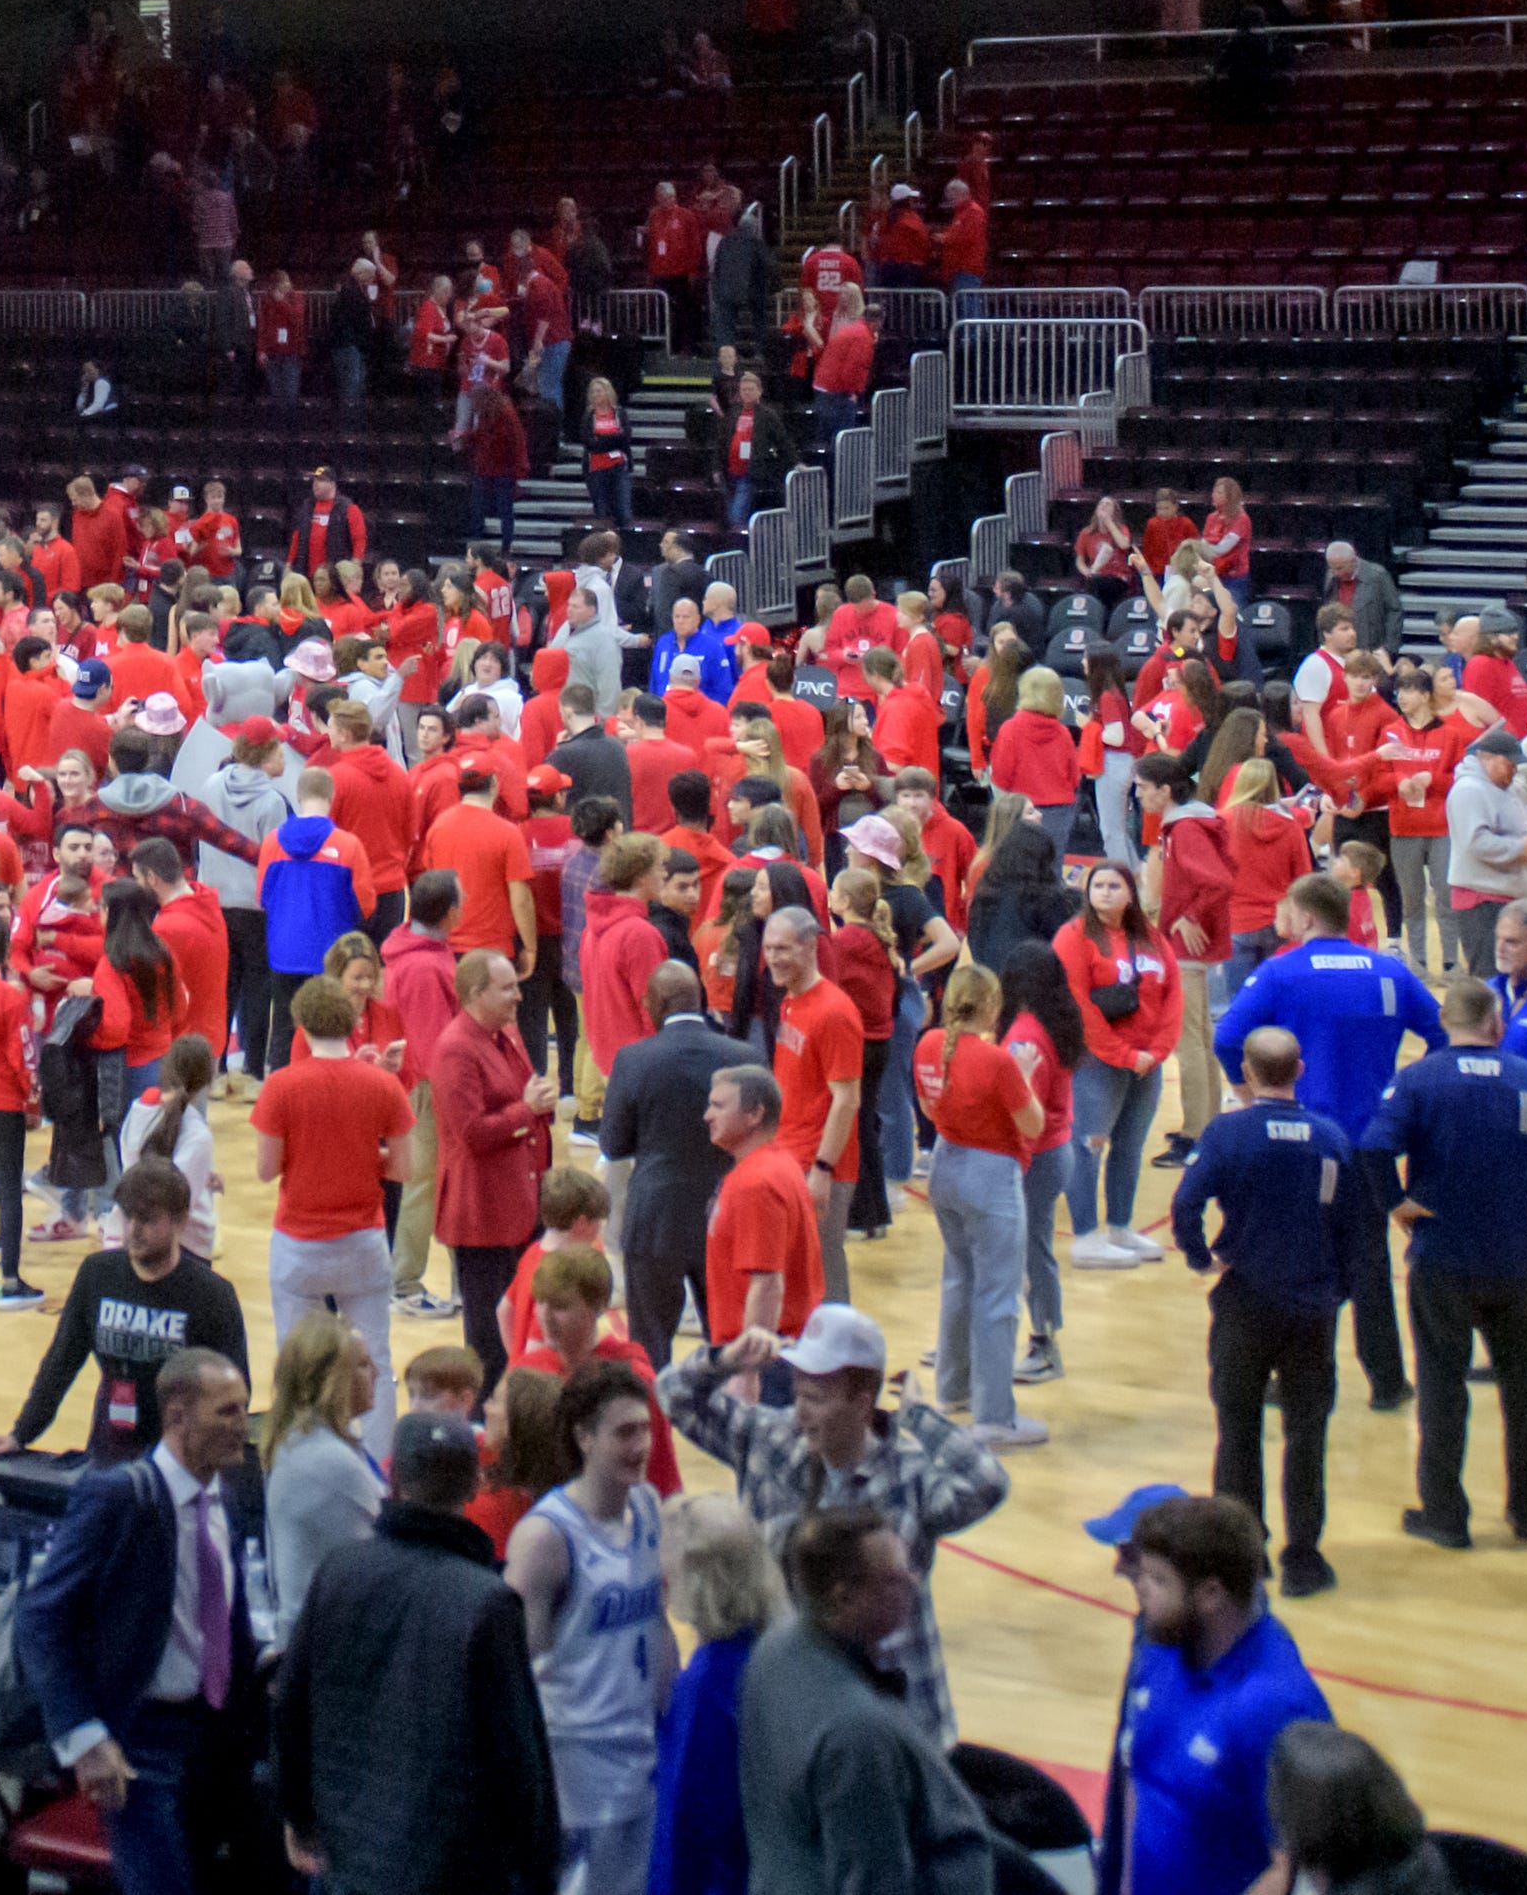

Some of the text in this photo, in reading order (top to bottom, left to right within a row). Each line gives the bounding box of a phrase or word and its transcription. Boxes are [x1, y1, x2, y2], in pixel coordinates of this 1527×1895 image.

[795, 680, 834, 697] PNC
[1310, 954, 1372, 971] SECURITY
[1456, 1056, 1501, 1078] STAFF
[1266, 1119, 1311, 1142] STAFF
[99, 1297, 188, 1340] DRAKE
